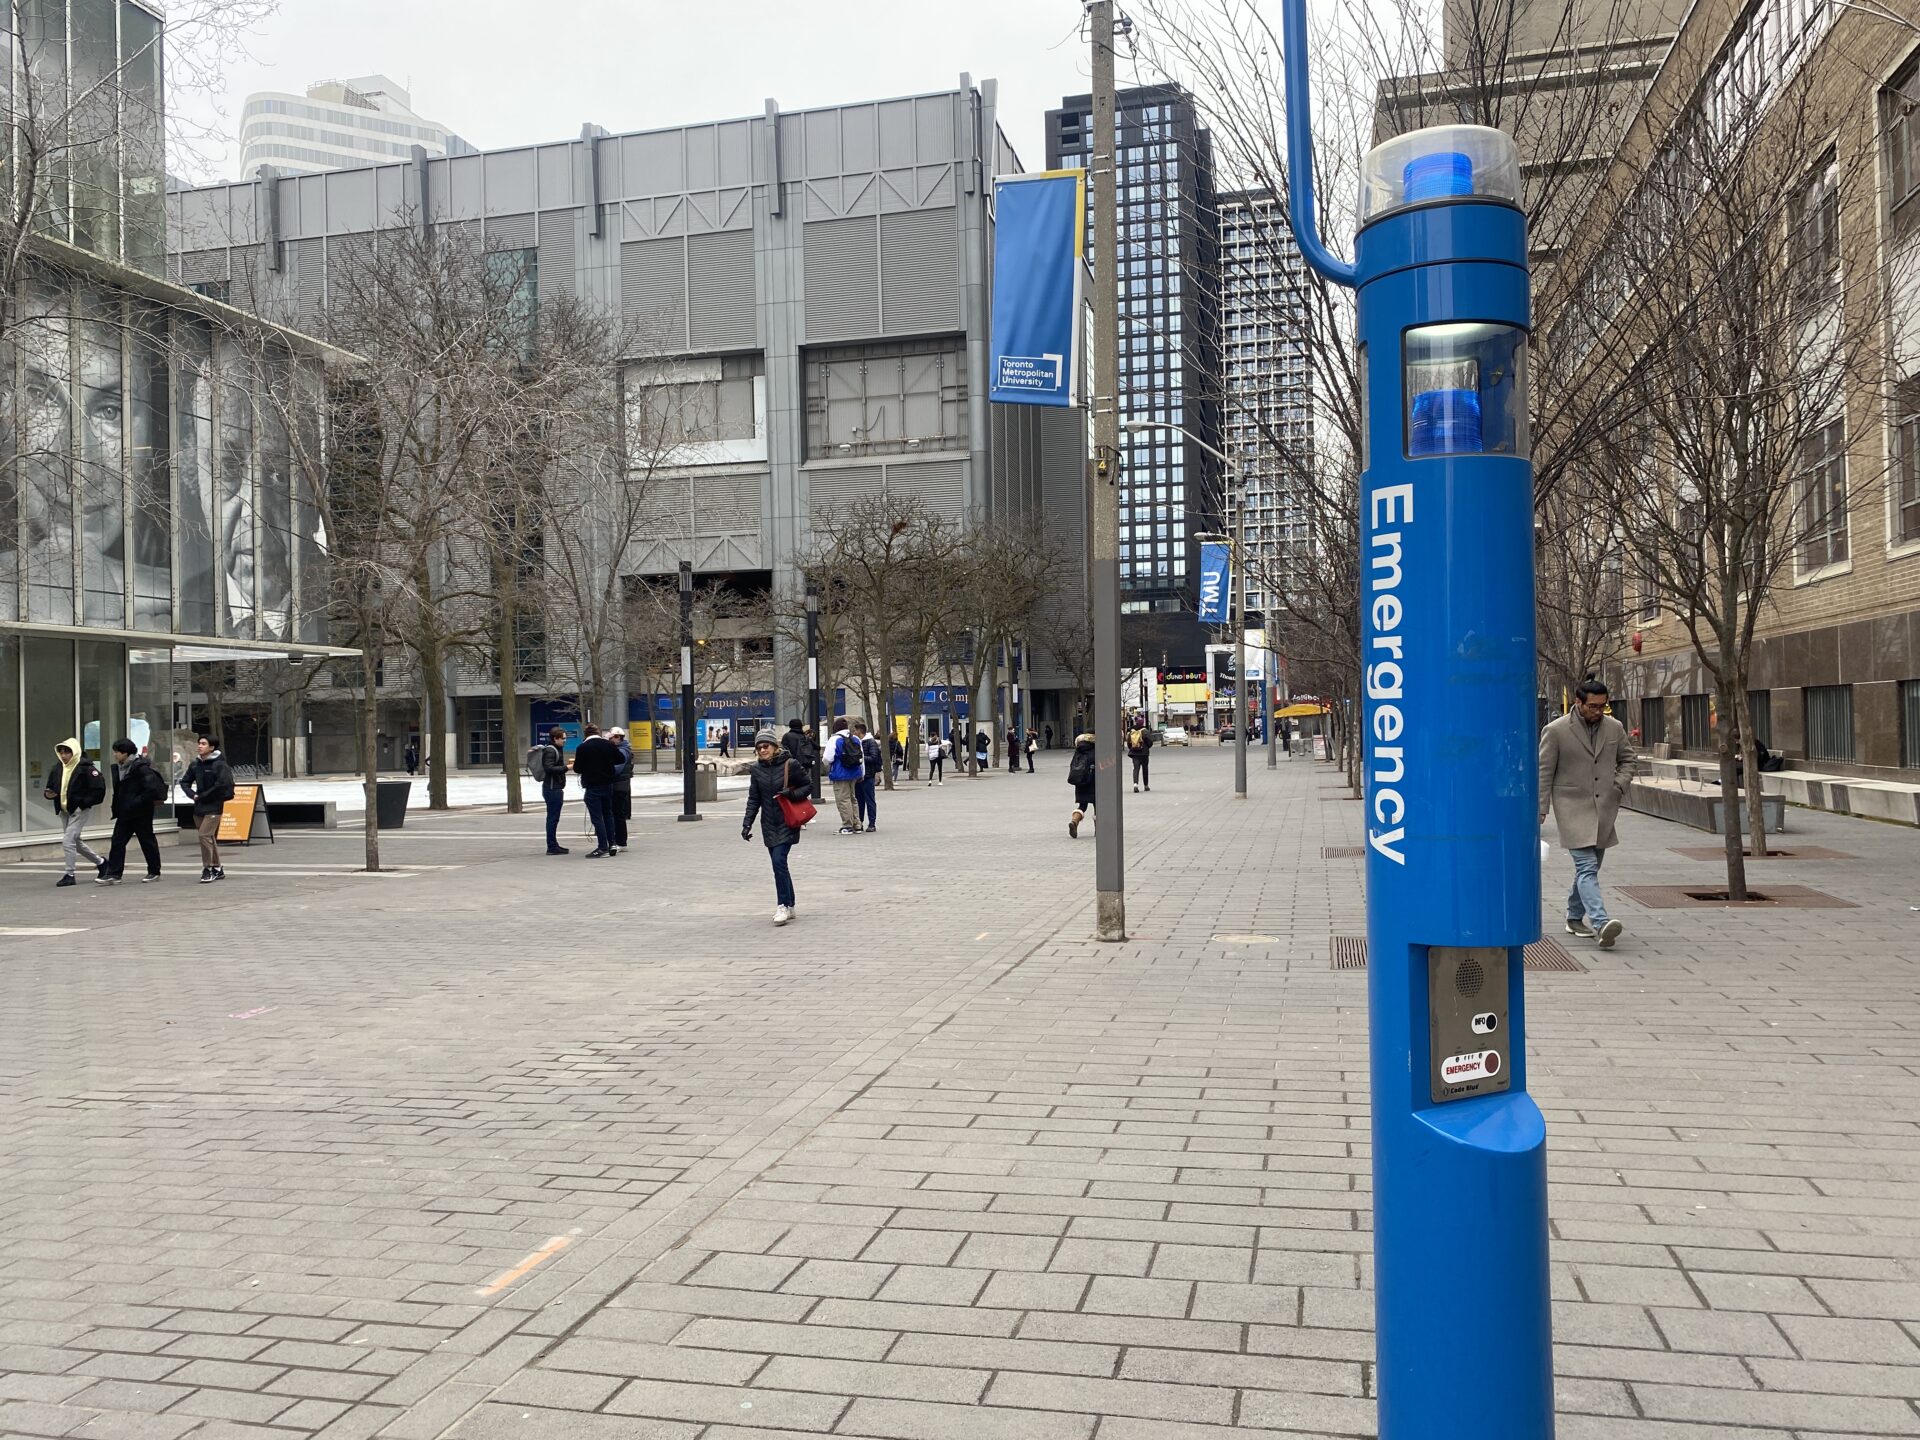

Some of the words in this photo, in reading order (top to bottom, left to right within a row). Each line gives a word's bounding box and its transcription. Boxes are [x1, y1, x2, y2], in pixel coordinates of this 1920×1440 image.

[1002, 359, 1034, 369] Toronto
[1002, 367, 1054, 379] Metropolitan
[1002, 376, 1043, 387] University
[1202, 571, 1221, 616] TMU
[1367, 483, 1414, 866] Emergency
[1475, 1017, 1485, 1025] INFO
[1446, 1062, 1481, 1075] EMERGENCY
[1466, 1084, 1479, 1092] Blue
